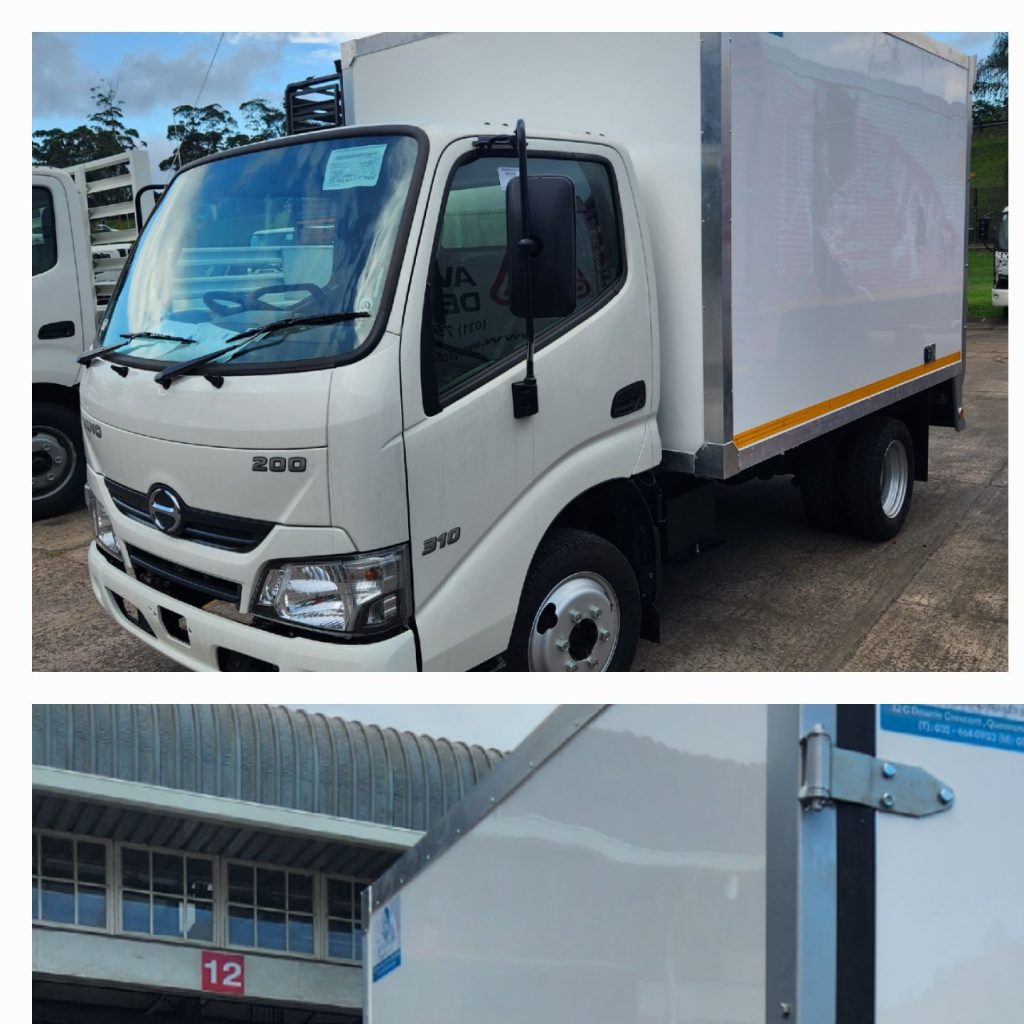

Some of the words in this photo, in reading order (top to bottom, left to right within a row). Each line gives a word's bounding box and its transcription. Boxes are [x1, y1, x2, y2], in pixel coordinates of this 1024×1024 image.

[251, 456, 307, 473] 200
[421, 526, 461, 556] 310
[204, 959, 242, 988] 12
